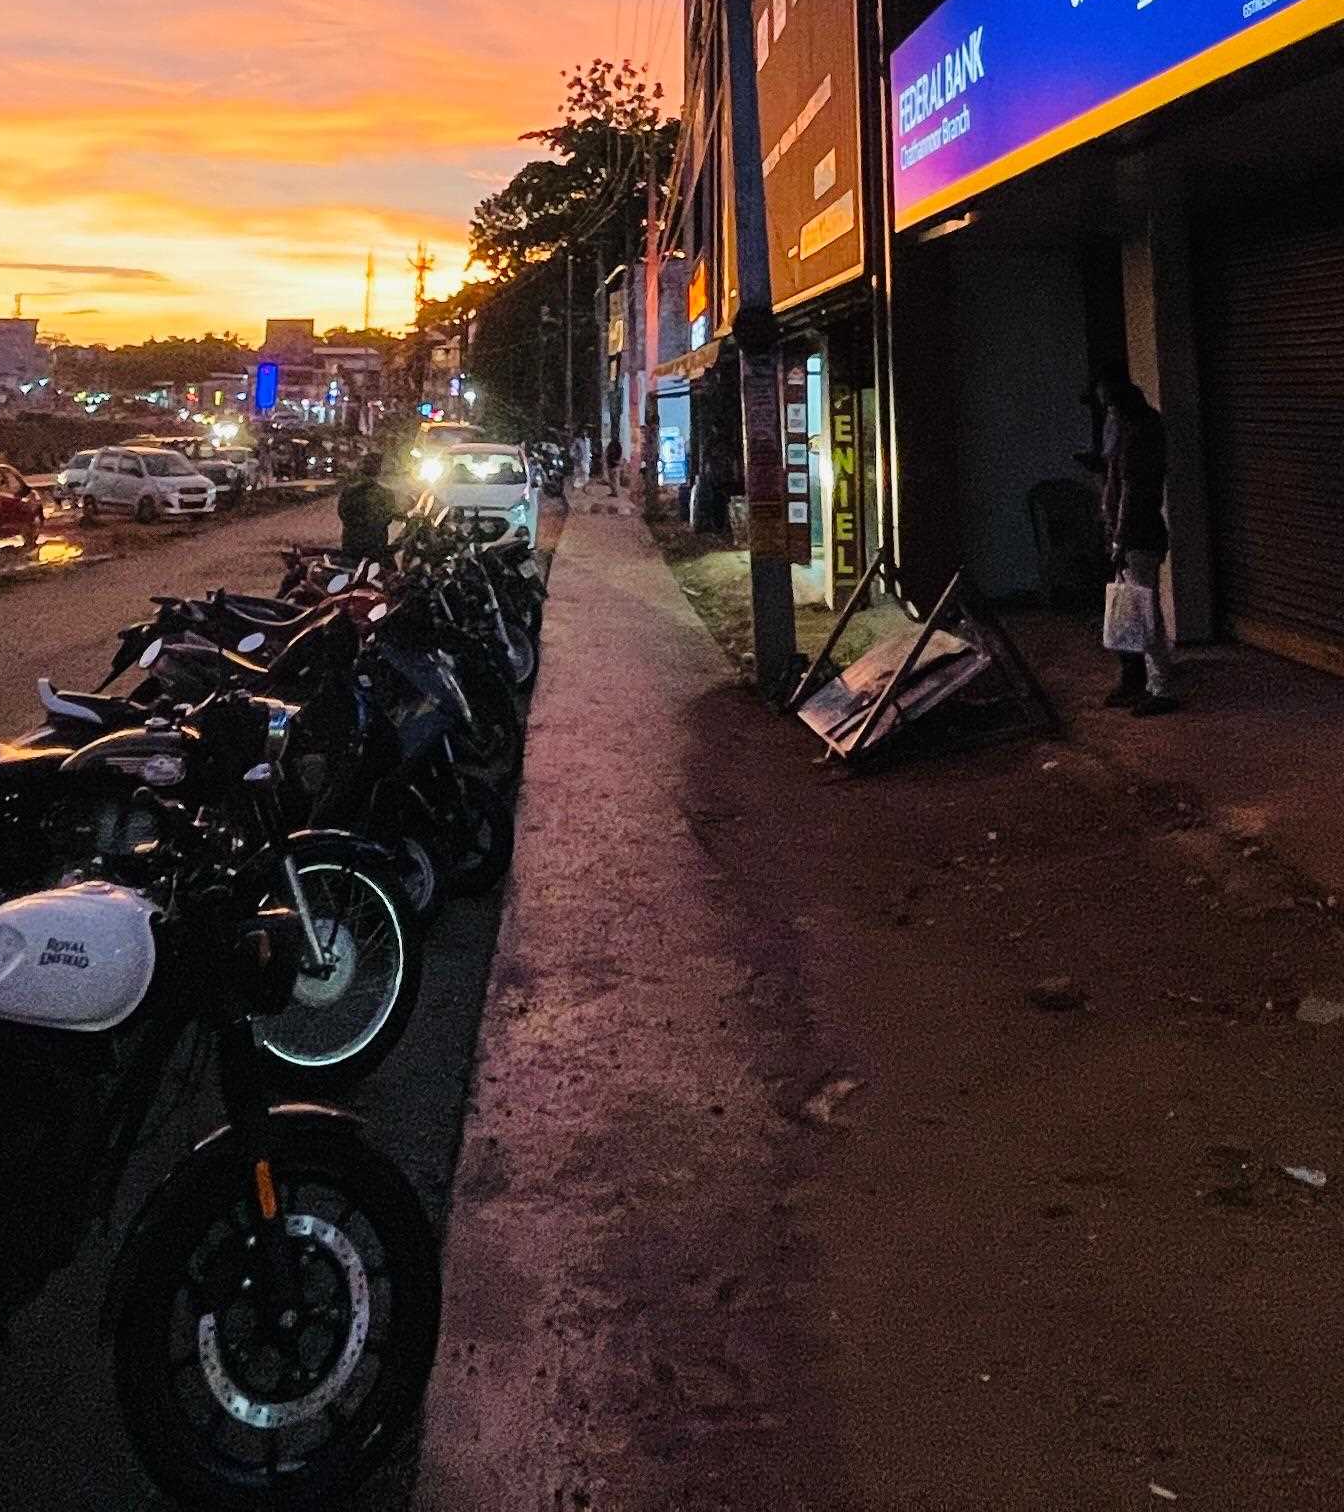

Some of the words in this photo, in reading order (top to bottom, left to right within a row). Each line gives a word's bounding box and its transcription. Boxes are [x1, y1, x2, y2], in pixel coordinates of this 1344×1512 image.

[898, 62, 945, 137] FEDERAL
[944, 25, 985, 104] BANK
[941, 103, 971, 145] Branch
[46, 937, 87, 953] ROYAL
